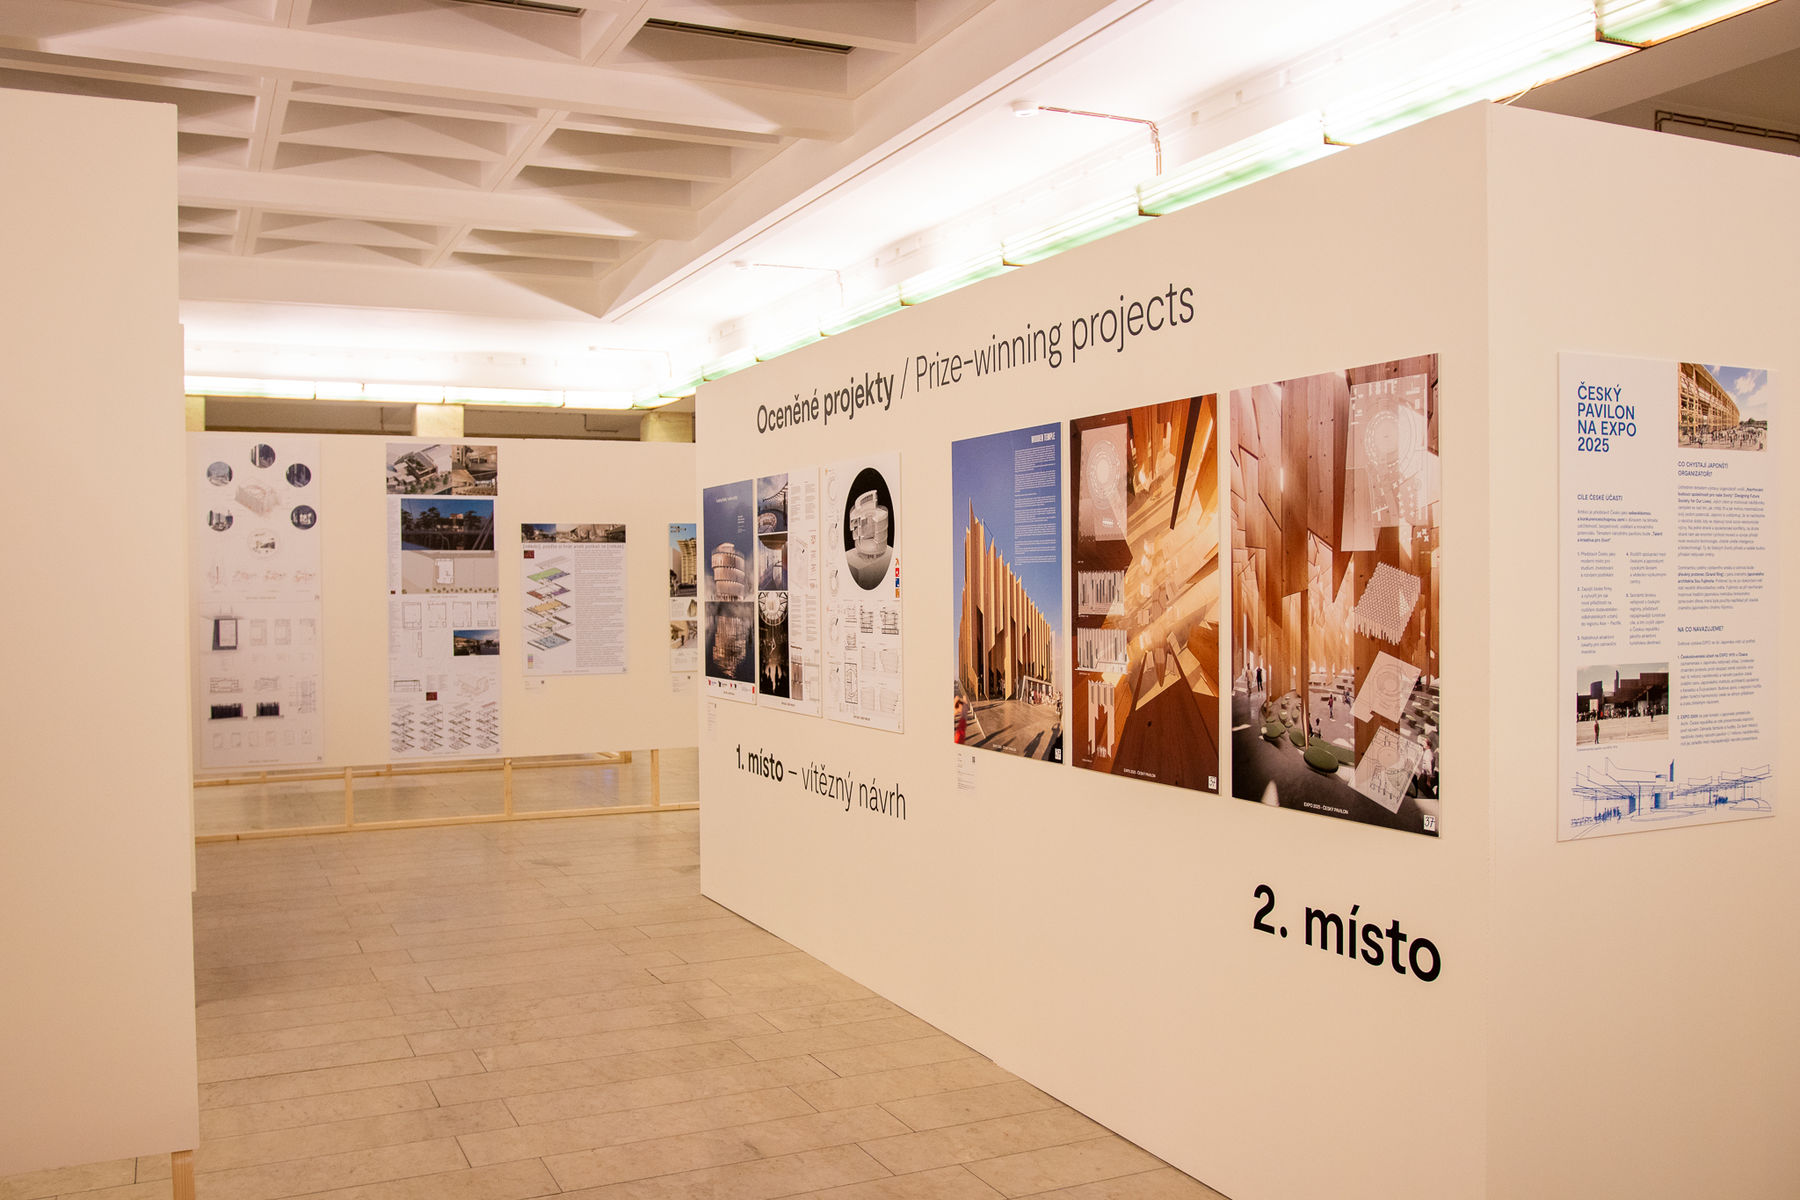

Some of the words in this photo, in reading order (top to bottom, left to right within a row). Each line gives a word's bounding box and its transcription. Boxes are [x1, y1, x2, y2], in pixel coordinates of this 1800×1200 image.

[757, 388, 820, 434] Oceněné
[824, 371, 895, 426] projekty
[900, 357, 910, 400] /
[917, 321, 1063, 393] Prize-winning
[1071, 283, 1196, 364] projects
[1577, 381, 1622, 402] ČESKÝ
[1577, 402, 1635, 420] PAVILON
[1577, 419, 1597, 435] NA
[1601, 421, 1637, 437] EXPO
[1577, 436, 1610, 453] 2025
[735, 744, 745, 770] 1.
[748, 748, 784, 782] místo
[802, 762, 854, 812] vítězný
[858, 777, 907, 821] návrh
[1252, 883, 1288, 939] 2.
[1304, 903, 1442, 983] místo
